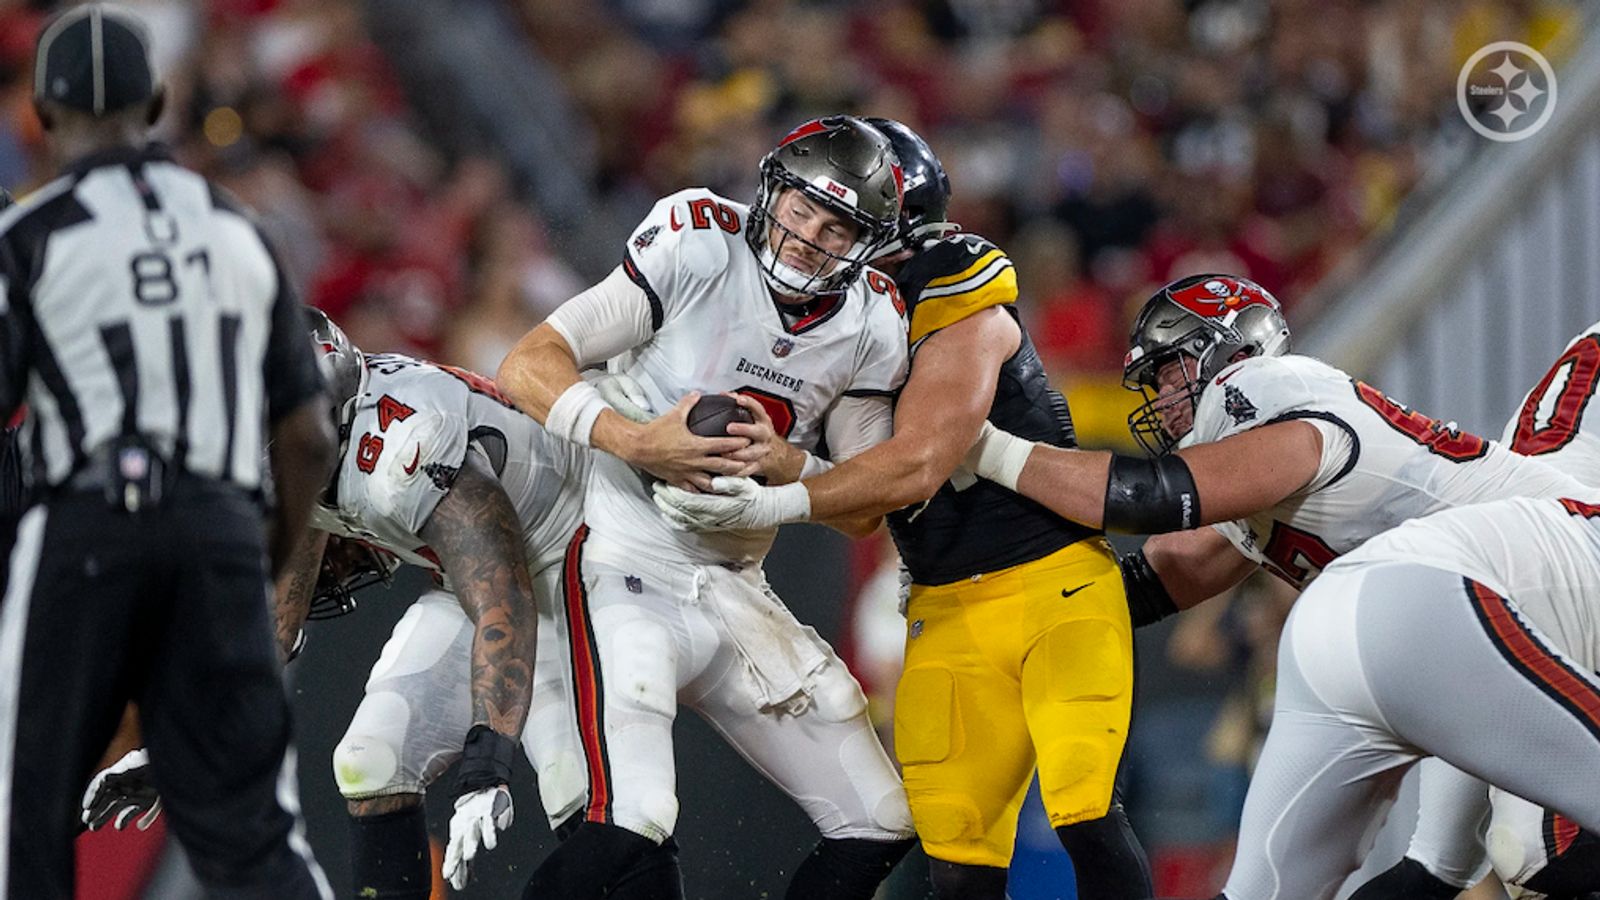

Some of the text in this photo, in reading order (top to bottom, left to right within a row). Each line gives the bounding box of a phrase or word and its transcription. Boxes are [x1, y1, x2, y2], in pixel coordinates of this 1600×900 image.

[687, 198, 741, 236] 2
[130, 248, 213, 306] 81
[356, 393, 417, 475] 64
